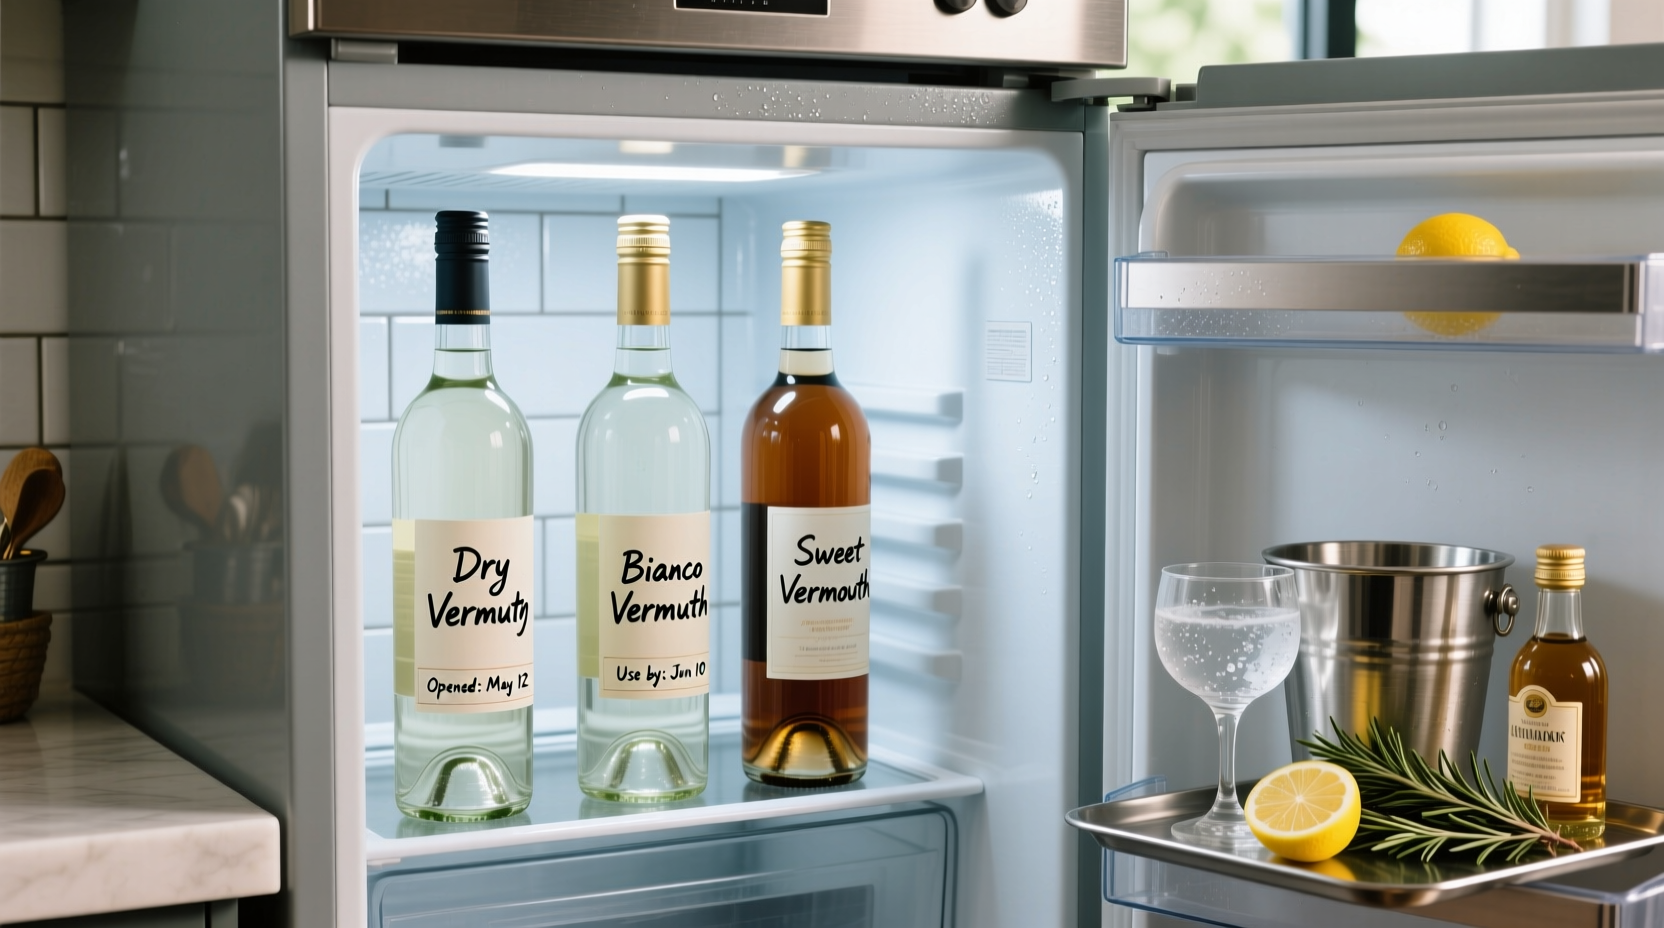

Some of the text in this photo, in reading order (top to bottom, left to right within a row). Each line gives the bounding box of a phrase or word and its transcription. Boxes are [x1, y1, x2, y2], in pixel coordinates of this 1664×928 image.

[621, 549, 703, 585] Bianco
[794, 534, 865, 566] Sweet
[453, 546, 510, 596] Dry
[780, 568, 870, 604] Vermouth
[610, 584, 708, 625] Vermuth
[426, 672, 529, 700] Opened: May 12
[616, 661, 706, 688] Use by: Jun 10
